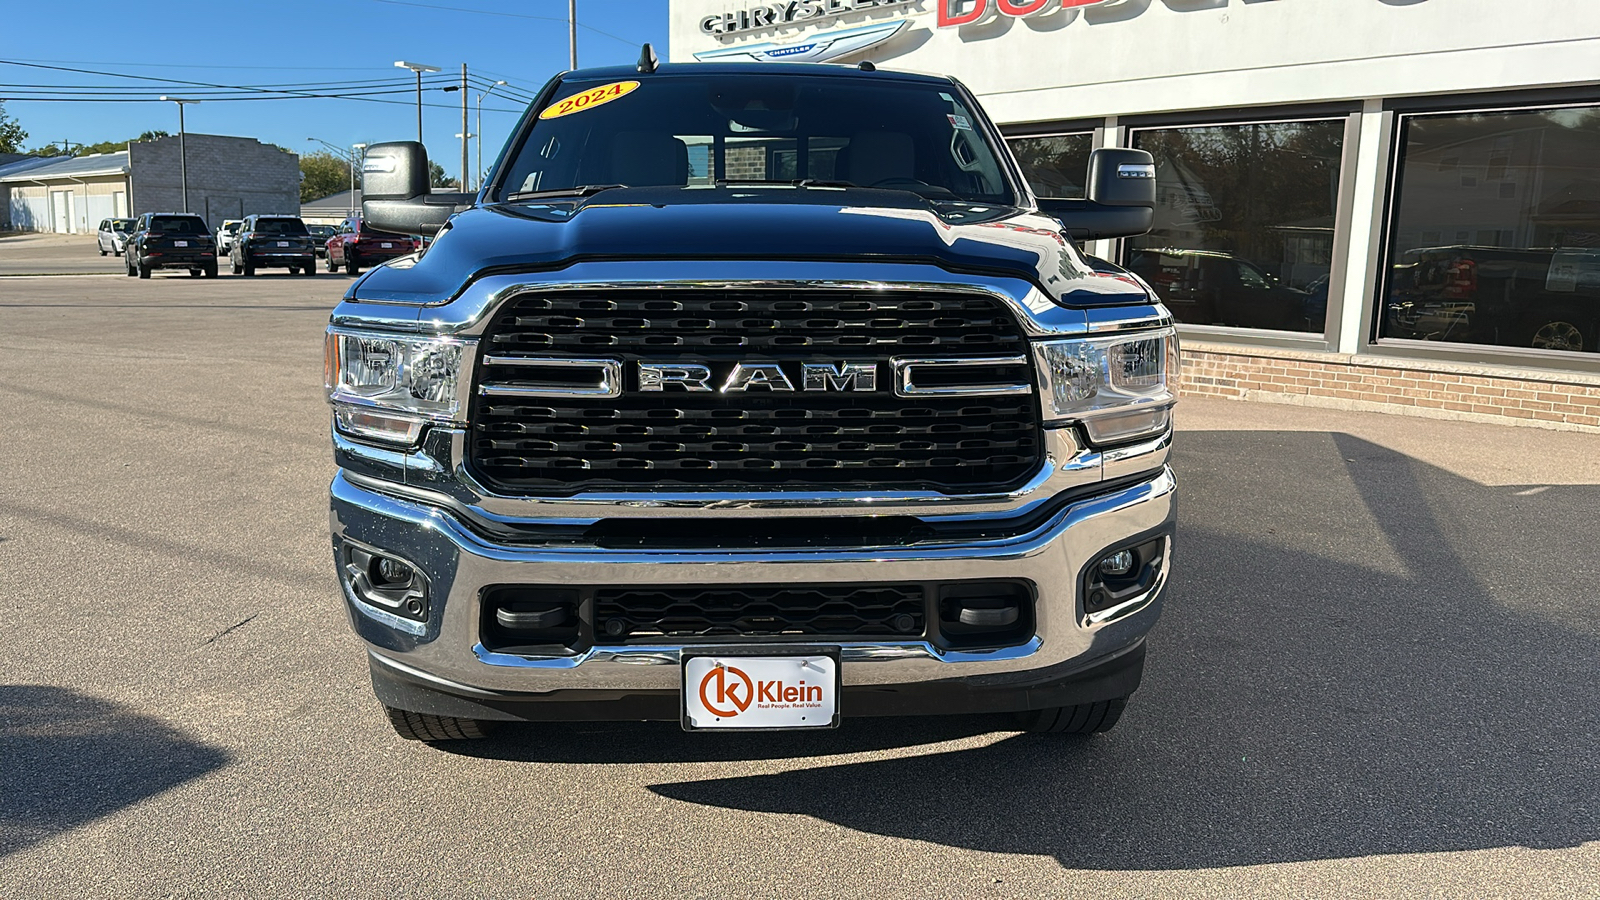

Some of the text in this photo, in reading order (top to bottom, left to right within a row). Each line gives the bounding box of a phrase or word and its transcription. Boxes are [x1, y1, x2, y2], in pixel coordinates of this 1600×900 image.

[699, 0, 904, 35] CHRYSL
[769, 46, 810, 56] CHRYSLER
[559, 84, 623, 114] 2024
[638, 360, 877, 393] RAM
[757, 680, 823, 703] Klein
